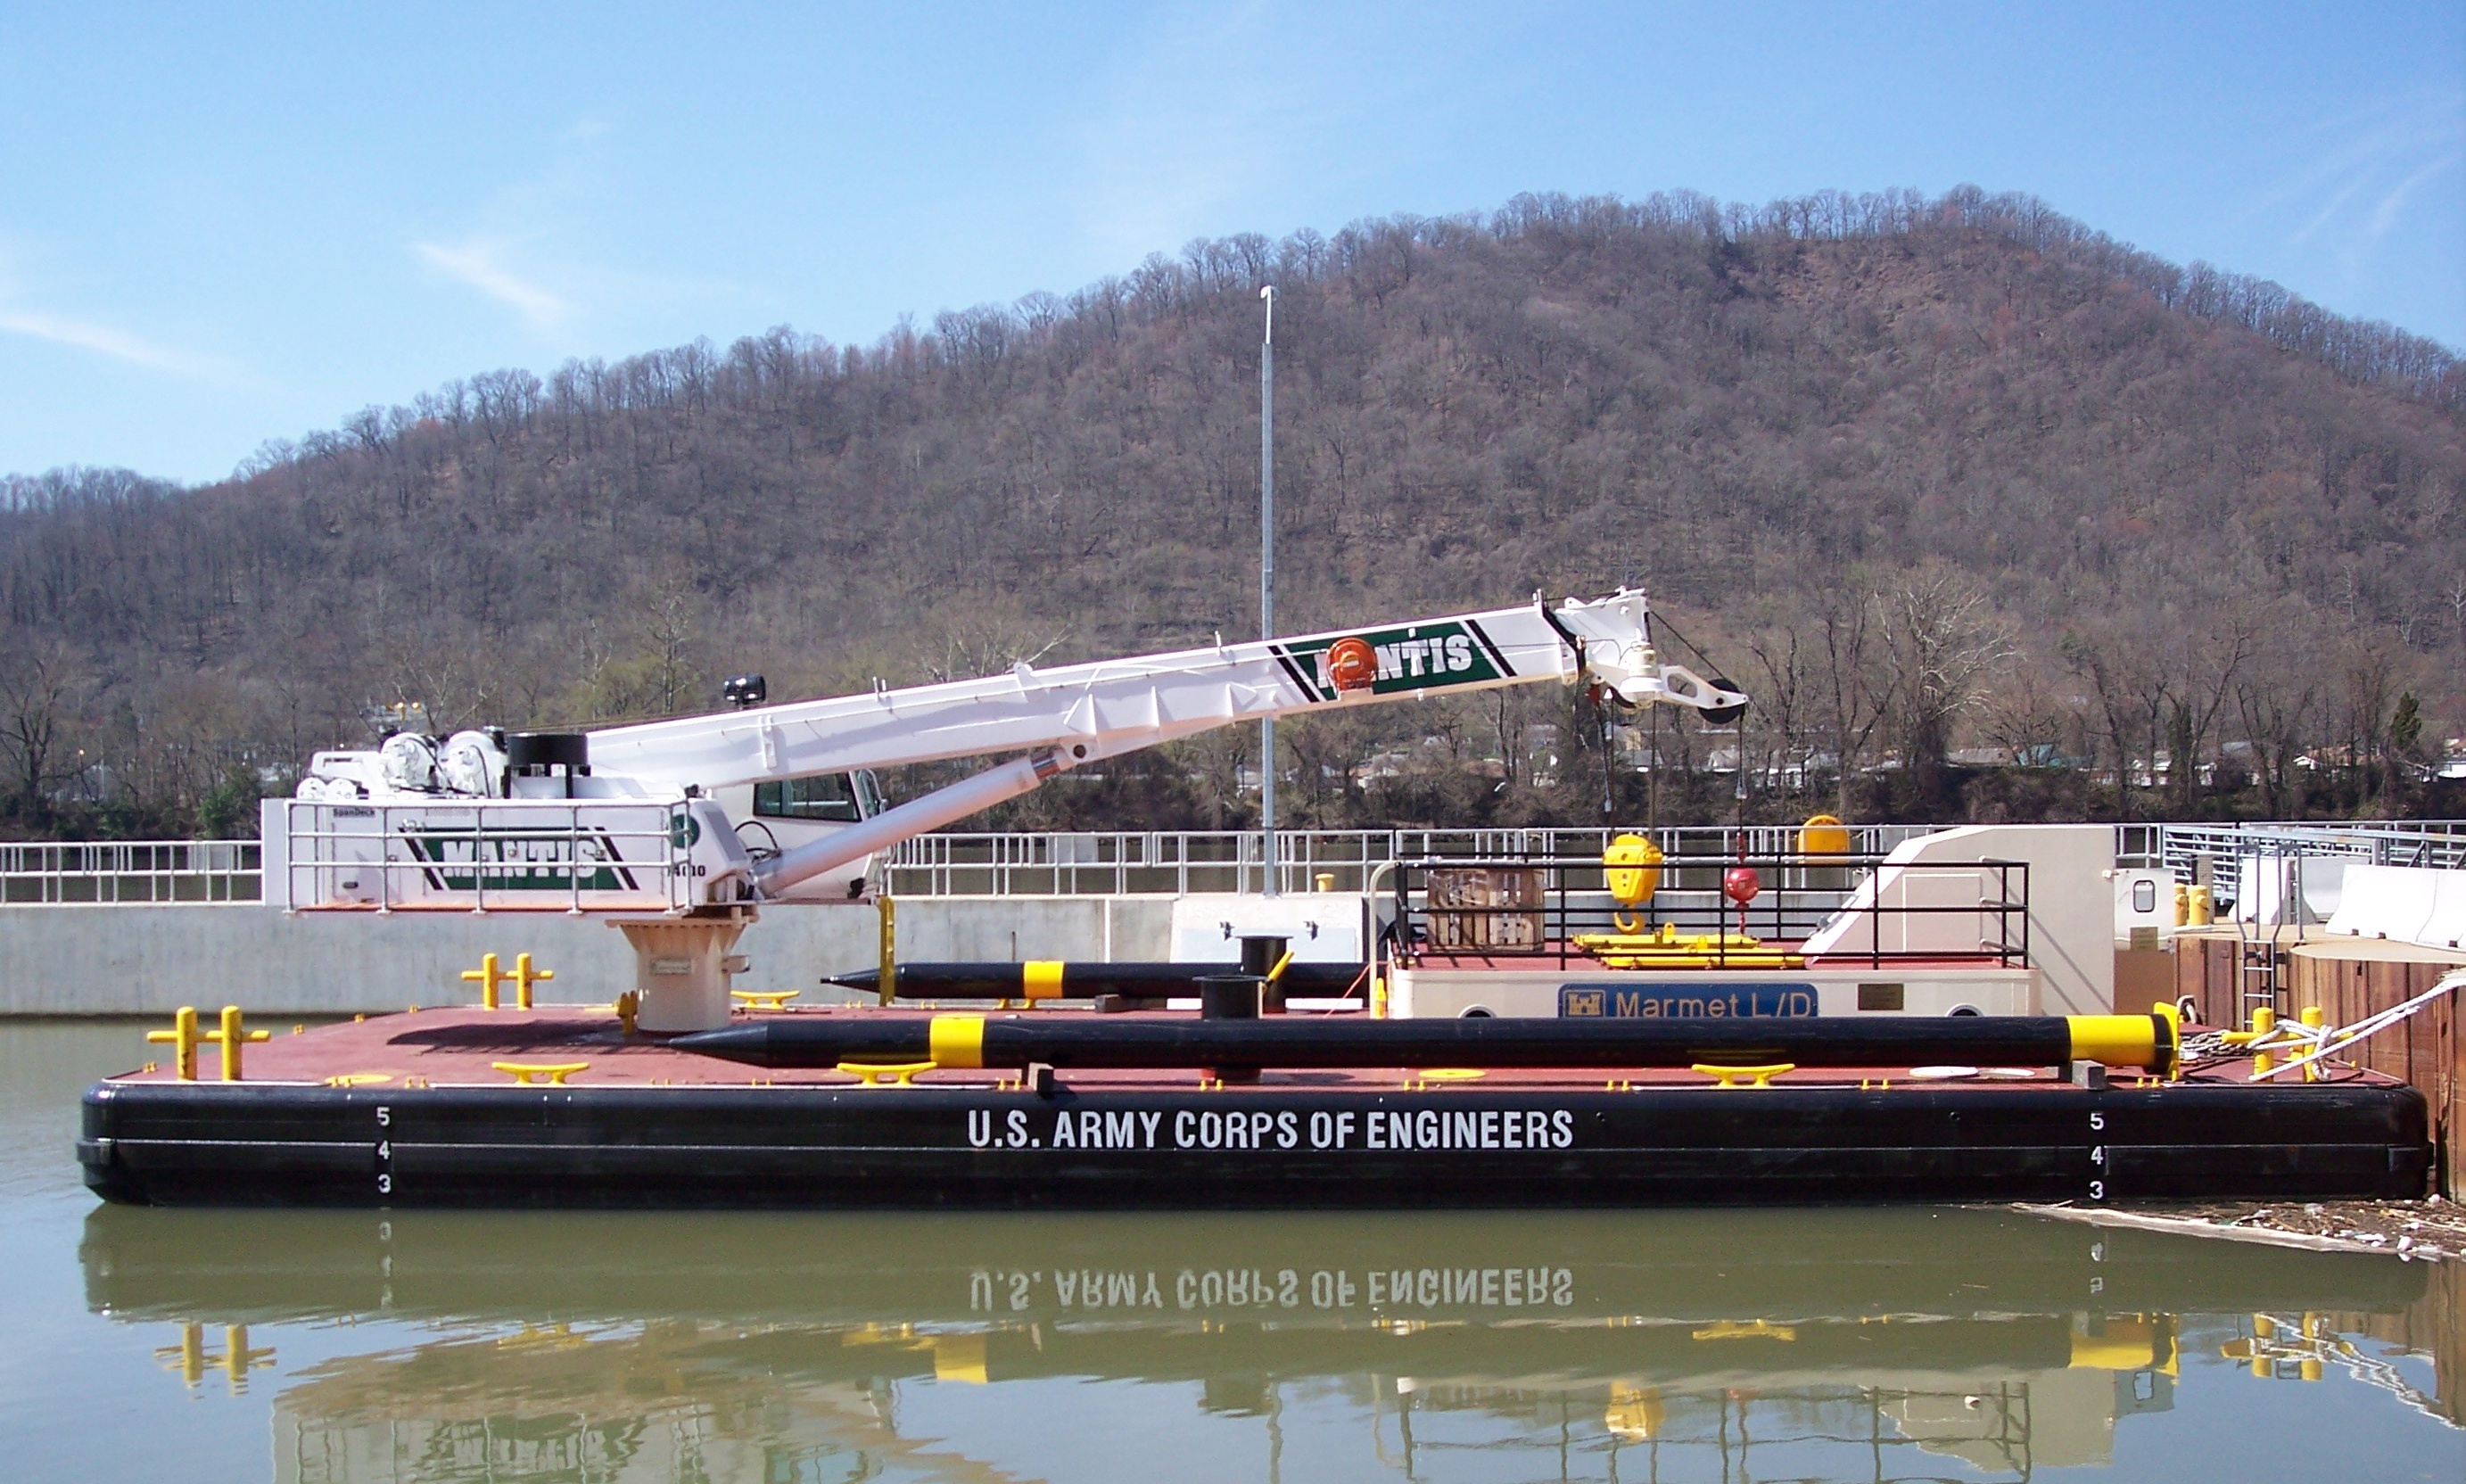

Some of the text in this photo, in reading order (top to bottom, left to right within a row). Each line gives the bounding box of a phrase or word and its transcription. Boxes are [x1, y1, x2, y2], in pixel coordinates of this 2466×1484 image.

[1313, 634, 1472, 688] NTIS
[442, 839, 598, 878] MANTIS
[1615, 991, 1812, 1018] Marmet L/D
[375, 1106, 391, 1126] 5
[2090, 1111, 2105, 1131] 5
[969, 1109, 1573, 1149] U.S. ARMY CORPS OF ENGINEERS
[377, 1140, 391, 1160] 4
[2091, 1145, 2104, 1166] 4
[377, 1174, 392, 1193] 3
[2089, 1180, 2104, 1200] 3
